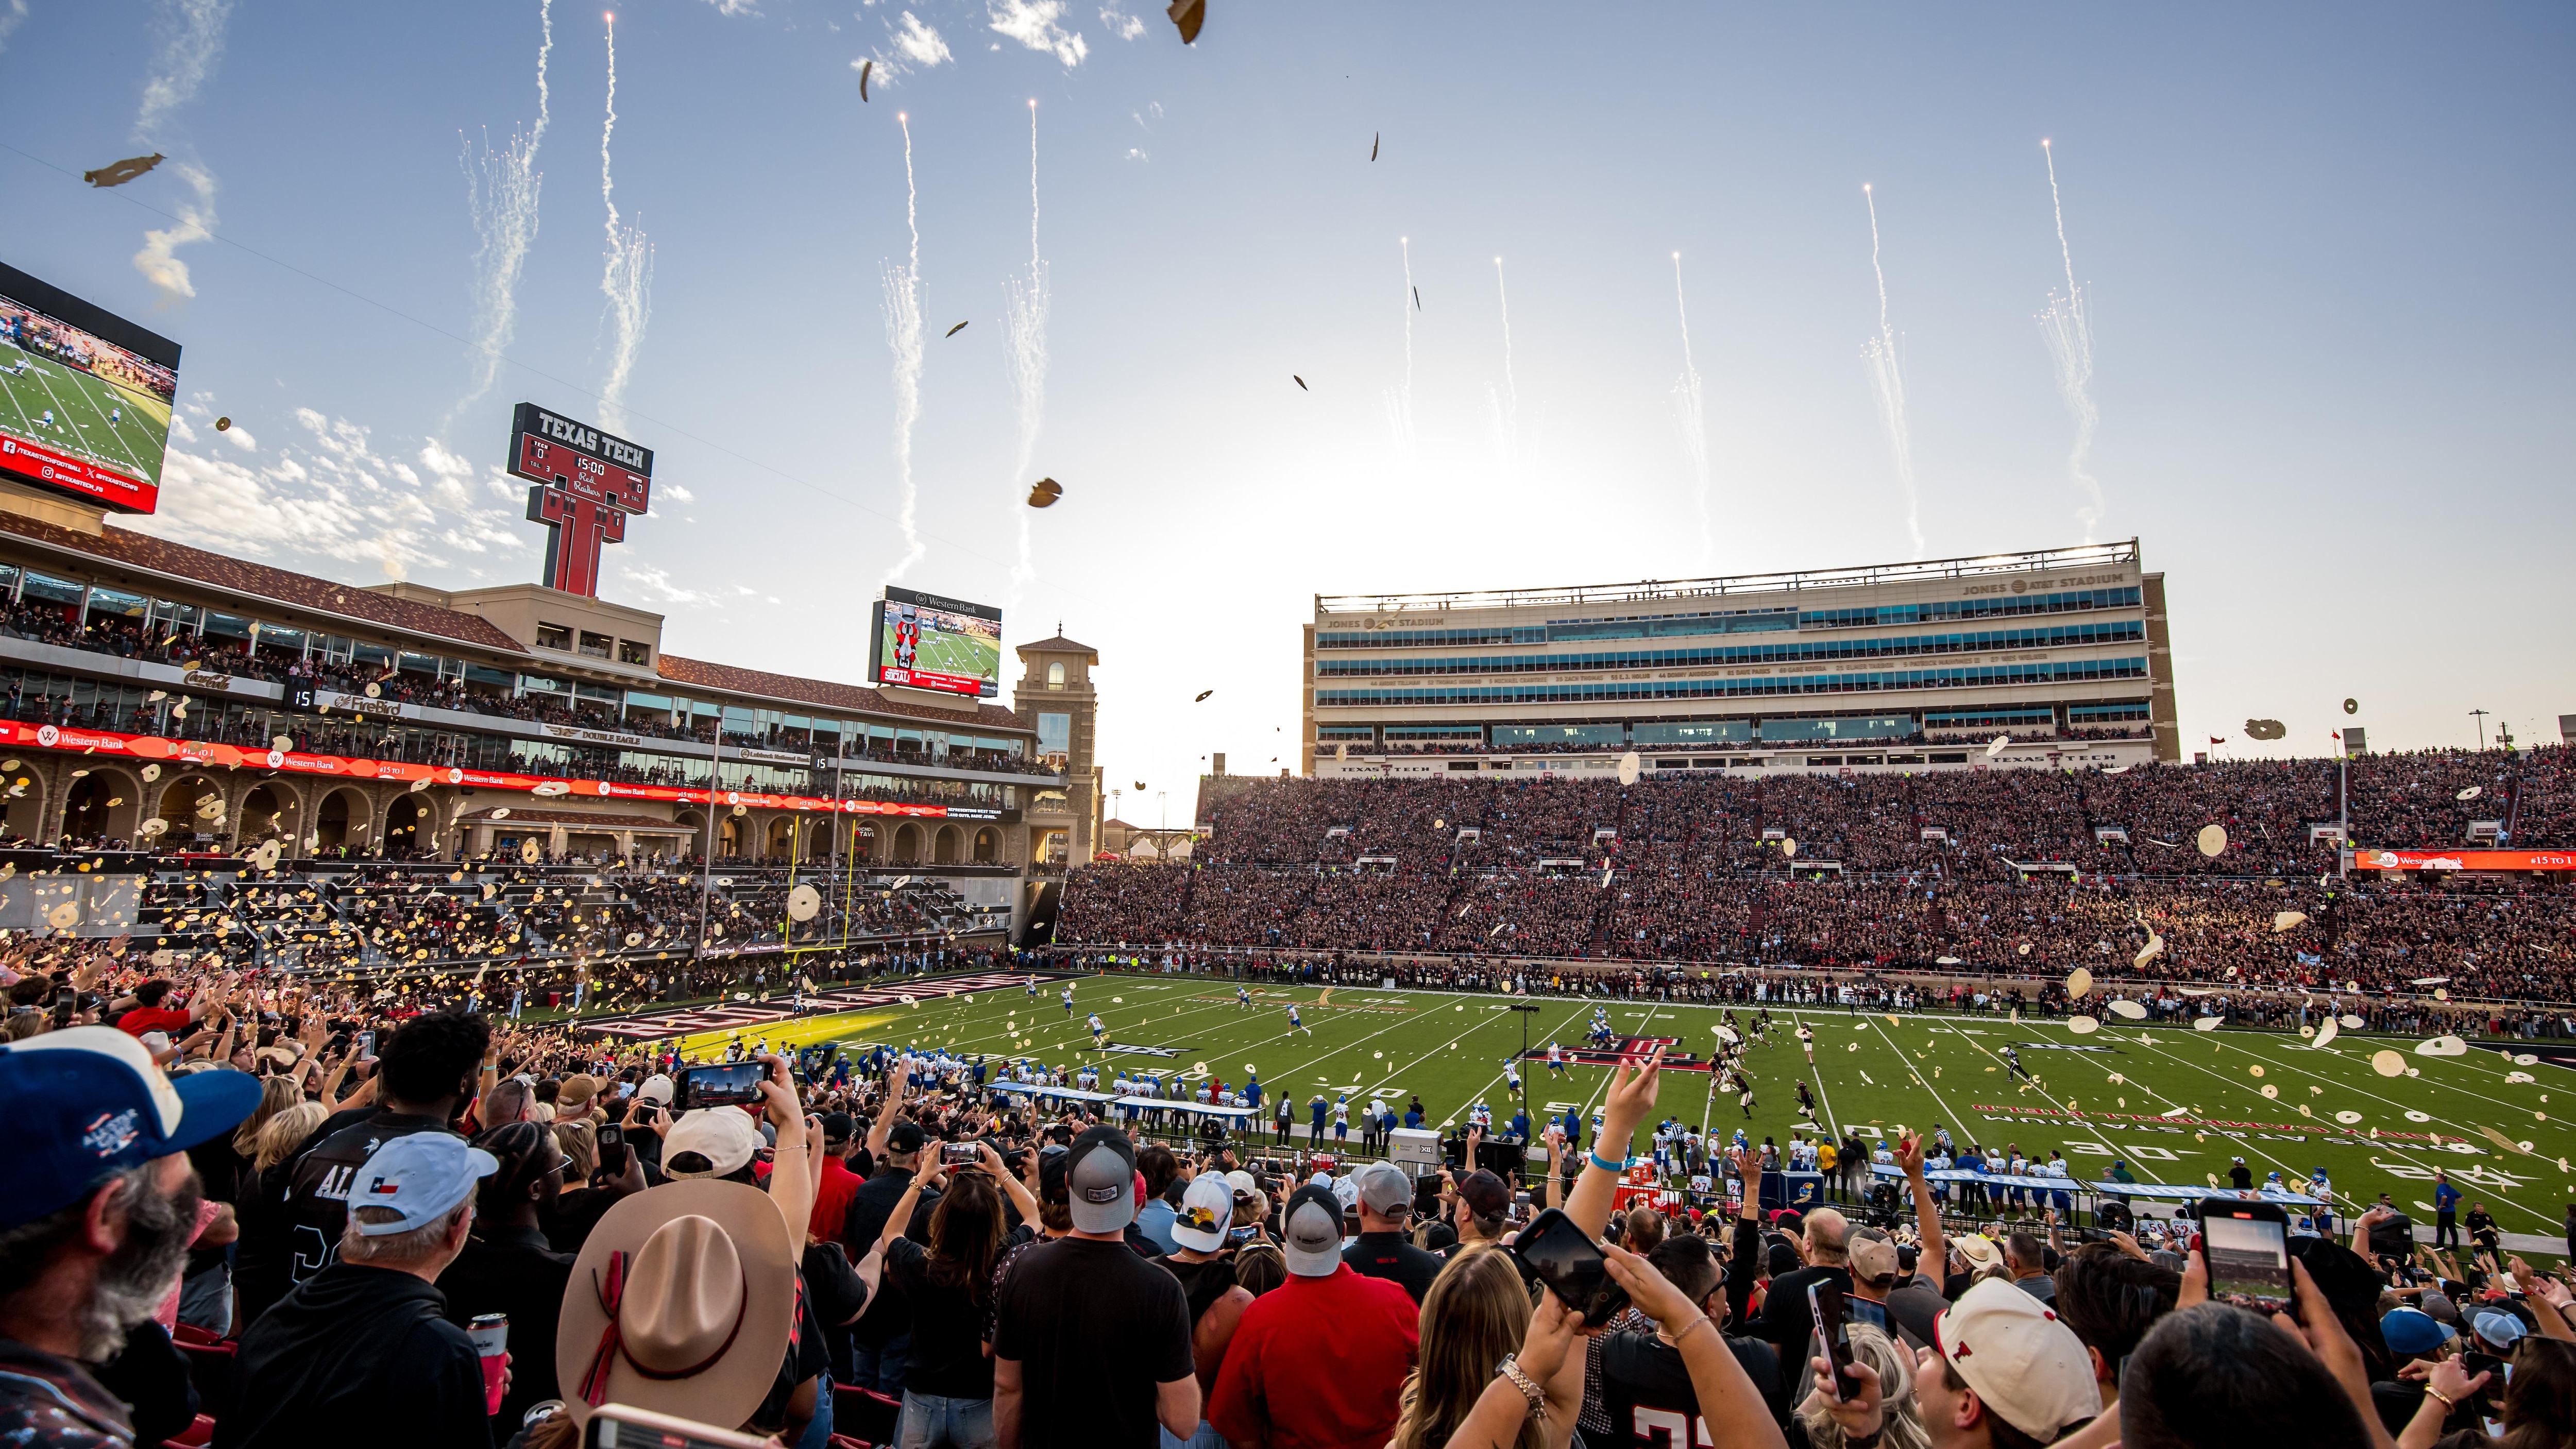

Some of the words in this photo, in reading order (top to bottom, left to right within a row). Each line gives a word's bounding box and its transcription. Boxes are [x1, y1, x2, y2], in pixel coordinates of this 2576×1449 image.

[534, 440, 548, 450] TECH
[539, 412, 598, 451] TEXAS
[601, 436, 643, 469] TECH
[17, 447, 81, 473] /TEXASTECHFOOTBALL
[537, 449, 544, 458] 0
[578, 457, 604, 475] 15:00
[55, 473, 103, 492] @TEXASTECH_FB
[96, 473, 138, 491] @TEXASTECHFB
[579, 472, 597, 485] Red
[628, 474, 642, 483] KANSAS
[574, 481, 601, 497] Raiders
[637, 484, 642, 493] 0
[1963, 584, 2007, 595] JONES
[2029, 580, 2054, 589] AT&T
[2060, 573, 2123, 587] STADIUM
[929, 596, 959, 610] Western
[959, 603, 976, 614] Bank
[1399, 618, 1444, 626] STADIUM
[885, 671, 910, 683] SOCIAL!
[296, 691, 310, 706] 15
[351, 696, 401, 716] FireBird
[61, 734, 99, 746] Western
[101, 738, 124, 749] Bank
[582, 731, 615, 741] DOUBLE
[615, 735, 640, 745] EAGLE
[285, 757, 315, 768] Western
[316, 760, 334, 769] Bank
[817, 758, 825, 769] 15
[464, 774, 488, 783] Western
[2531, 856, 2548, 864] #15
[585, 1005, 796, 1037] RED
[1079, 1080, 1087, 1088] 10
[1221, 1099, 1230, 1107] 25
[1971, 1104, 2089, 1117] FIELD
[1982, 1114, 2198, 1135] STADIUM
[2092, 1113, 2329, 1133] CAMPBELL
[1658, 1139, 1667, 1149] 18
[1809, 1154, 1814, 1163] 6
[1633, 1169, 1640, 1178] G
[315, 1165, 353, 1201] AL
[1695, 1183, 1707, 1192] 27
[2115, 1185, 2306, 1204] FOOTBLL
[2175, 1225, 2188, 1236] 52
